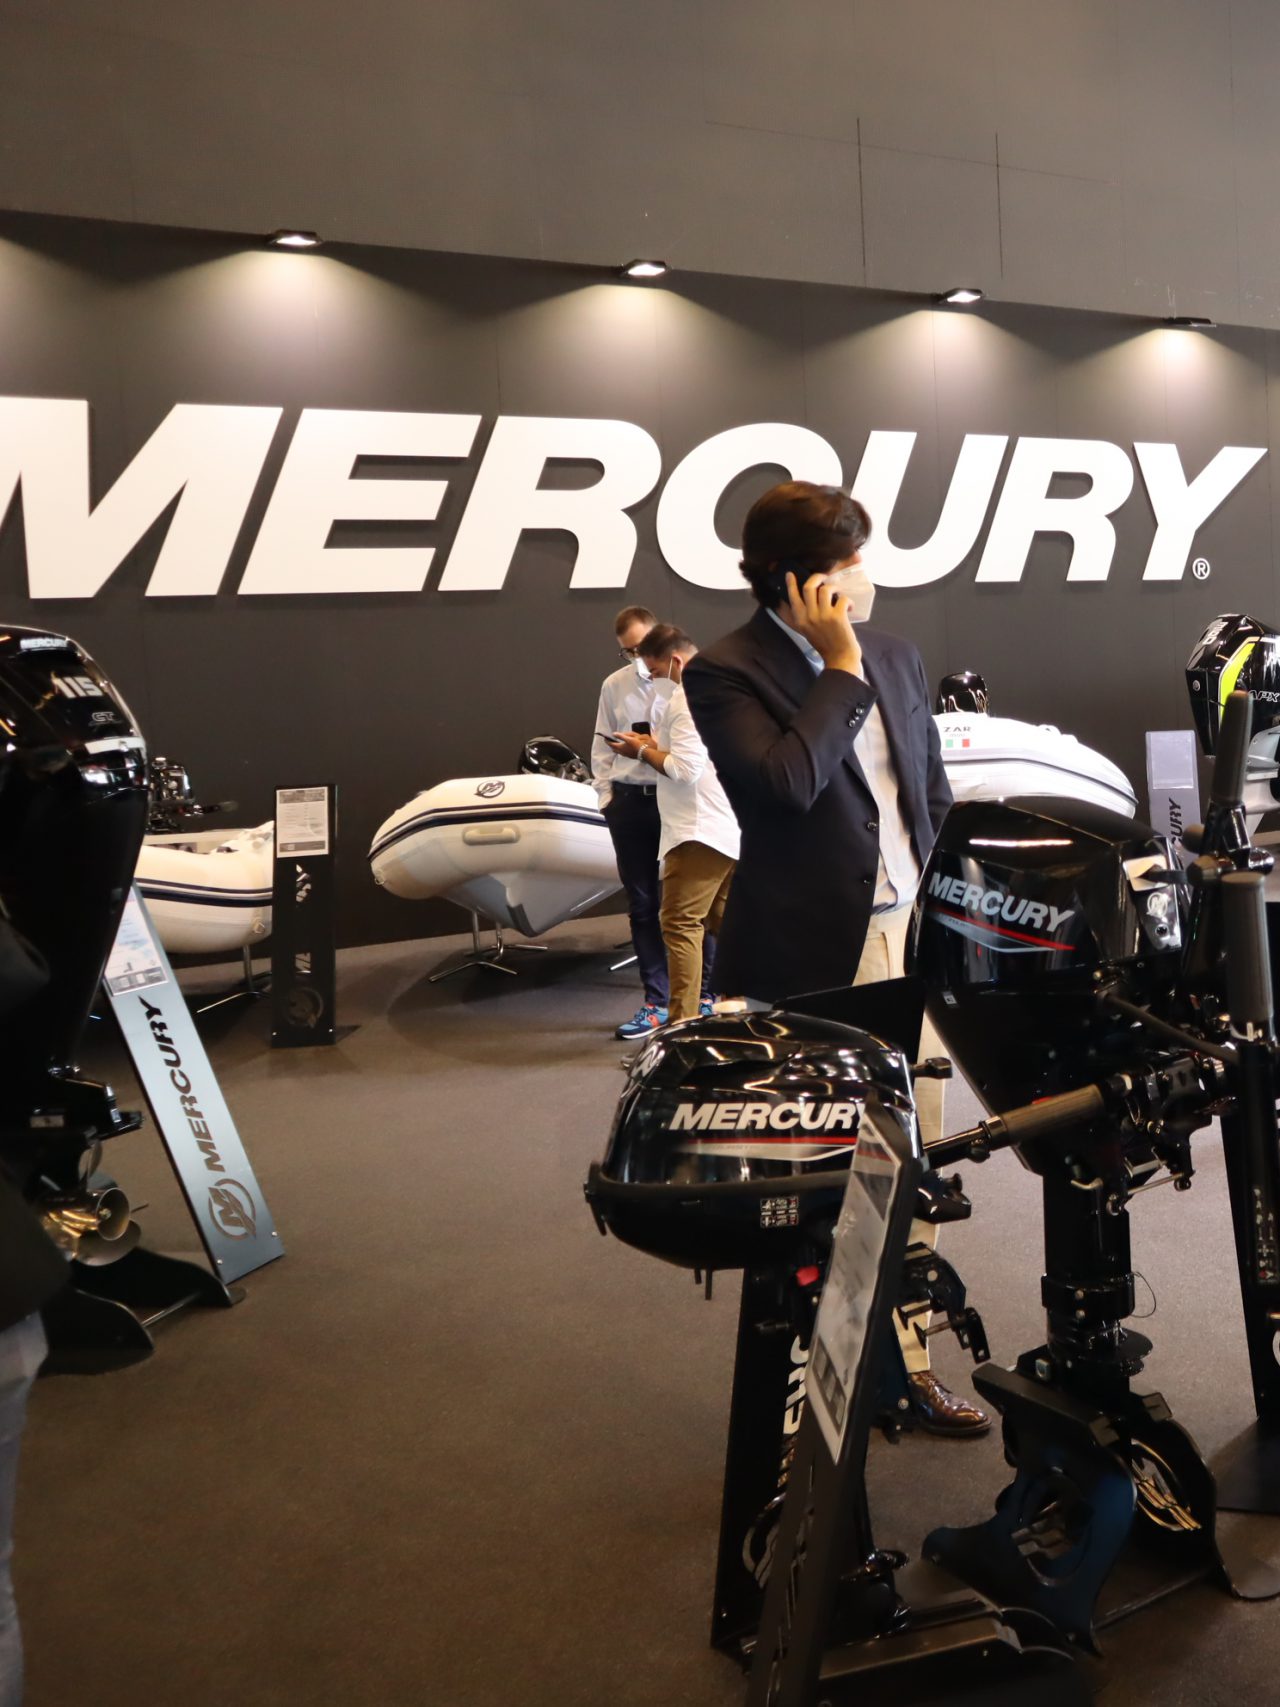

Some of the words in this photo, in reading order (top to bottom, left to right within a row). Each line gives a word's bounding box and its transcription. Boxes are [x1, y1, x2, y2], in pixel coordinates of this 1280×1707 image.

[0, 397, 1267, 600] MERCURY
[928, 872, 1075, 933] MERCURY
[137, 995, 226, 1173] MERCURY
[669, 1102, 865, 1131] MERCUR
